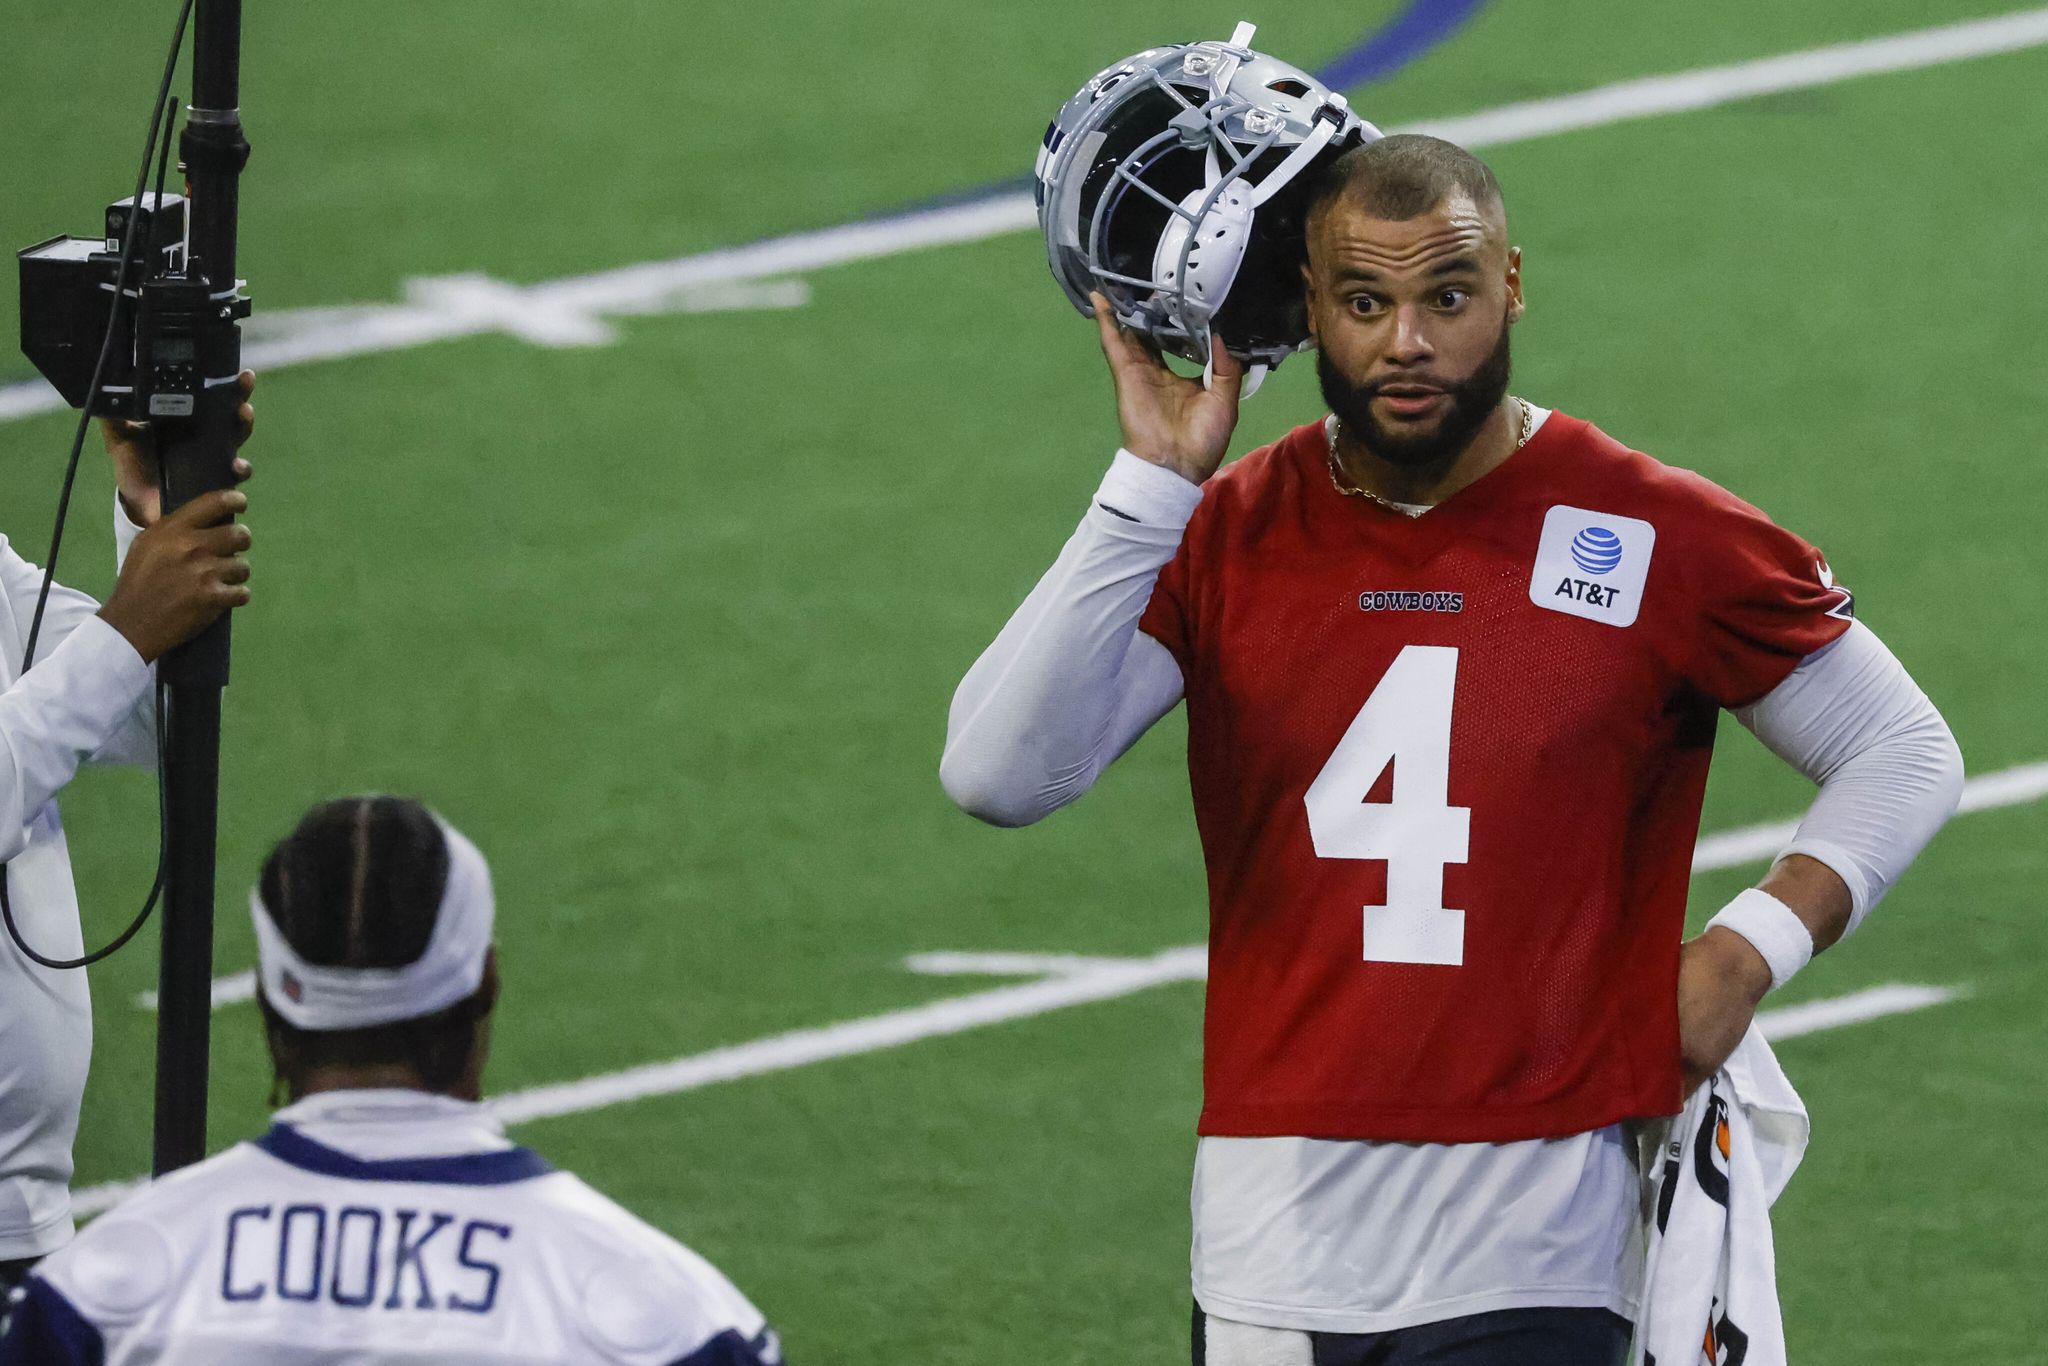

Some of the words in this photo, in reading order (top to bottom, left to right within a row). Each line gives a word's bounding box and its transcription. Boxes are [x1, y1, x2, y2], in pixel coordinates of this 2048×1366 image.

[1359, 591, 1463, 612] COWBOYS
[1554, 577, 1620, 608] AT&T
[1303, 645, 1471, 966] 4
[221, 1203, 512, 1313] COOKS
